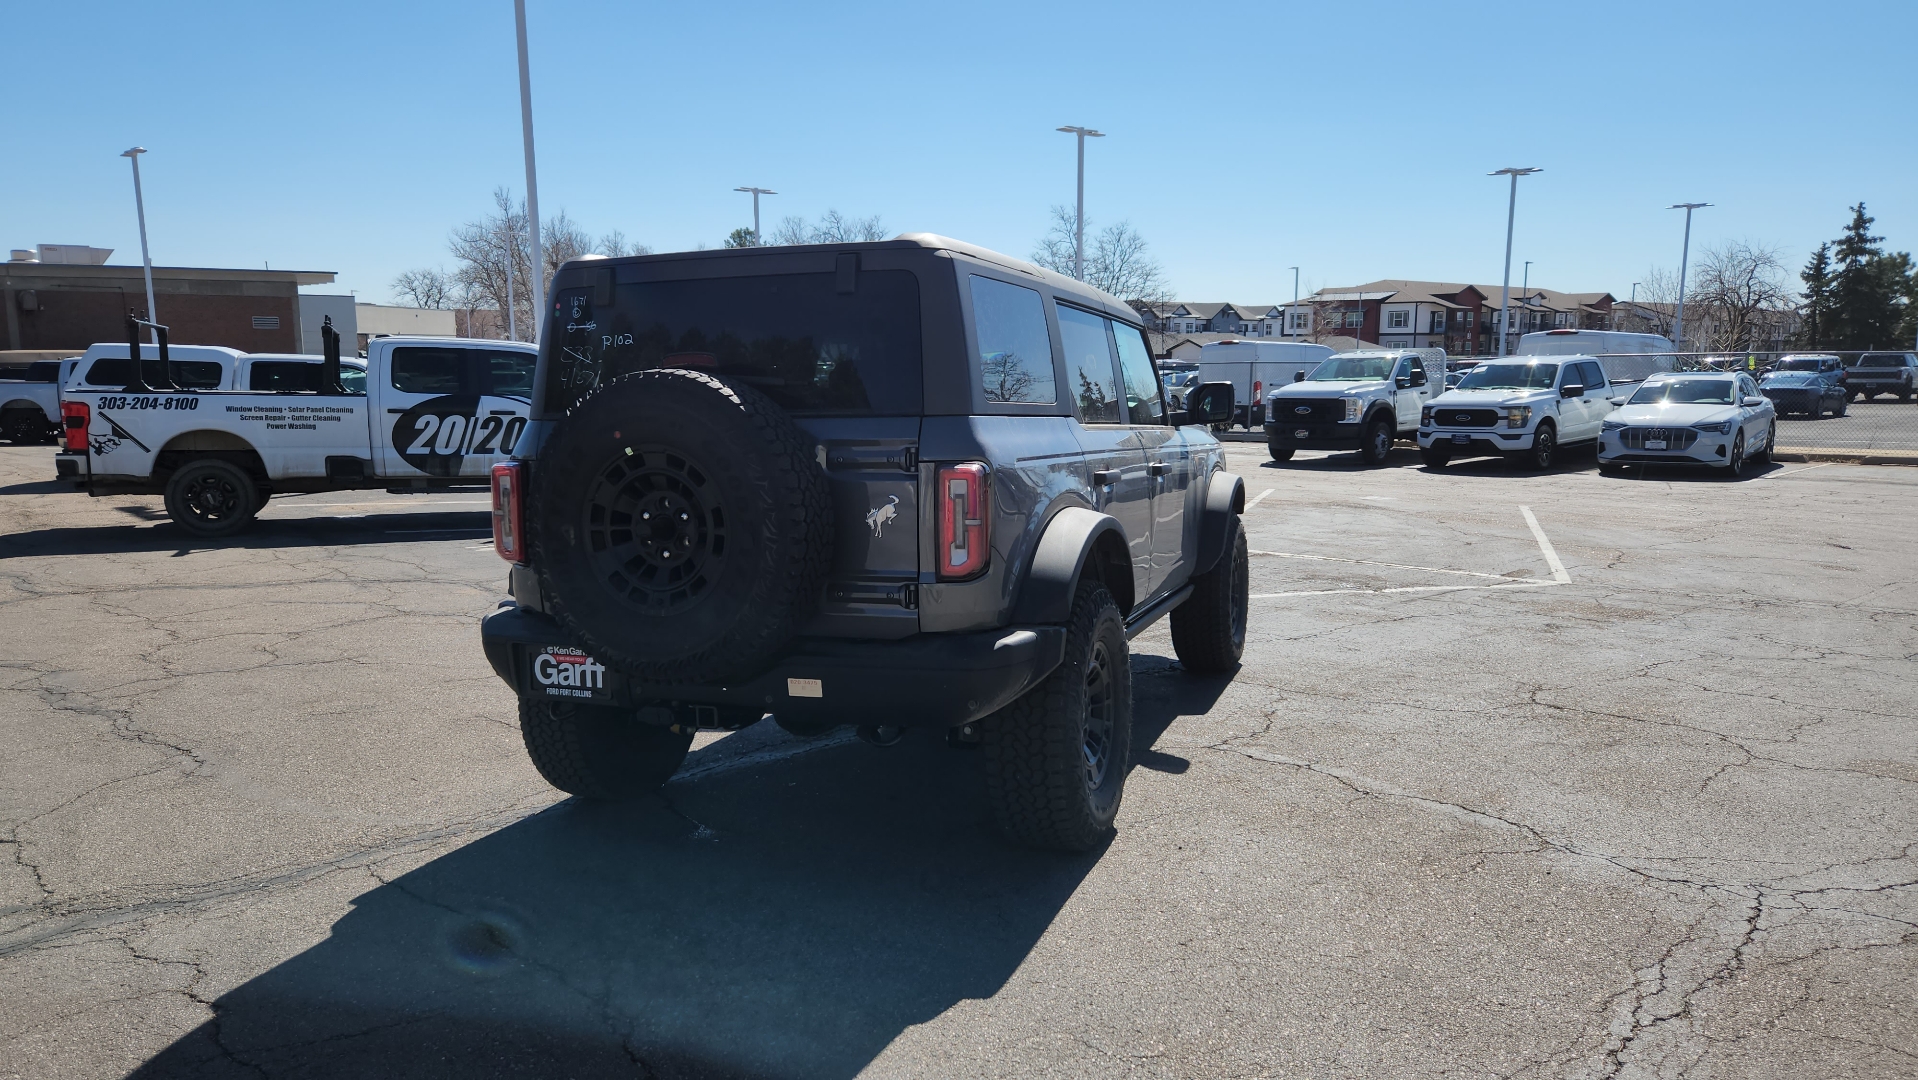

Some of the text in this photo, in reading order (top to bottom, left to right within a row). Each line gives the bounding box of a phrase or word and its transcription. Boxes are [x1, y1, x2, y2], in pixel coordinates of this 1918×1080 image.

[97, 396, 199, 411] 303-204-8100
[253, 406, 283, 414] Cleaning
[325, 406, 354, 414] Cleaning
[264, 414, 286, 422] Repair
[312, 414, 341, 422] Cleaning
[287, 423, 317, 431] Washing
[553, 646, 569, 655] Ken
[569, 647, 588, 656] Gar
[546, 687, 592, 698] FORD FORT COLLINS
